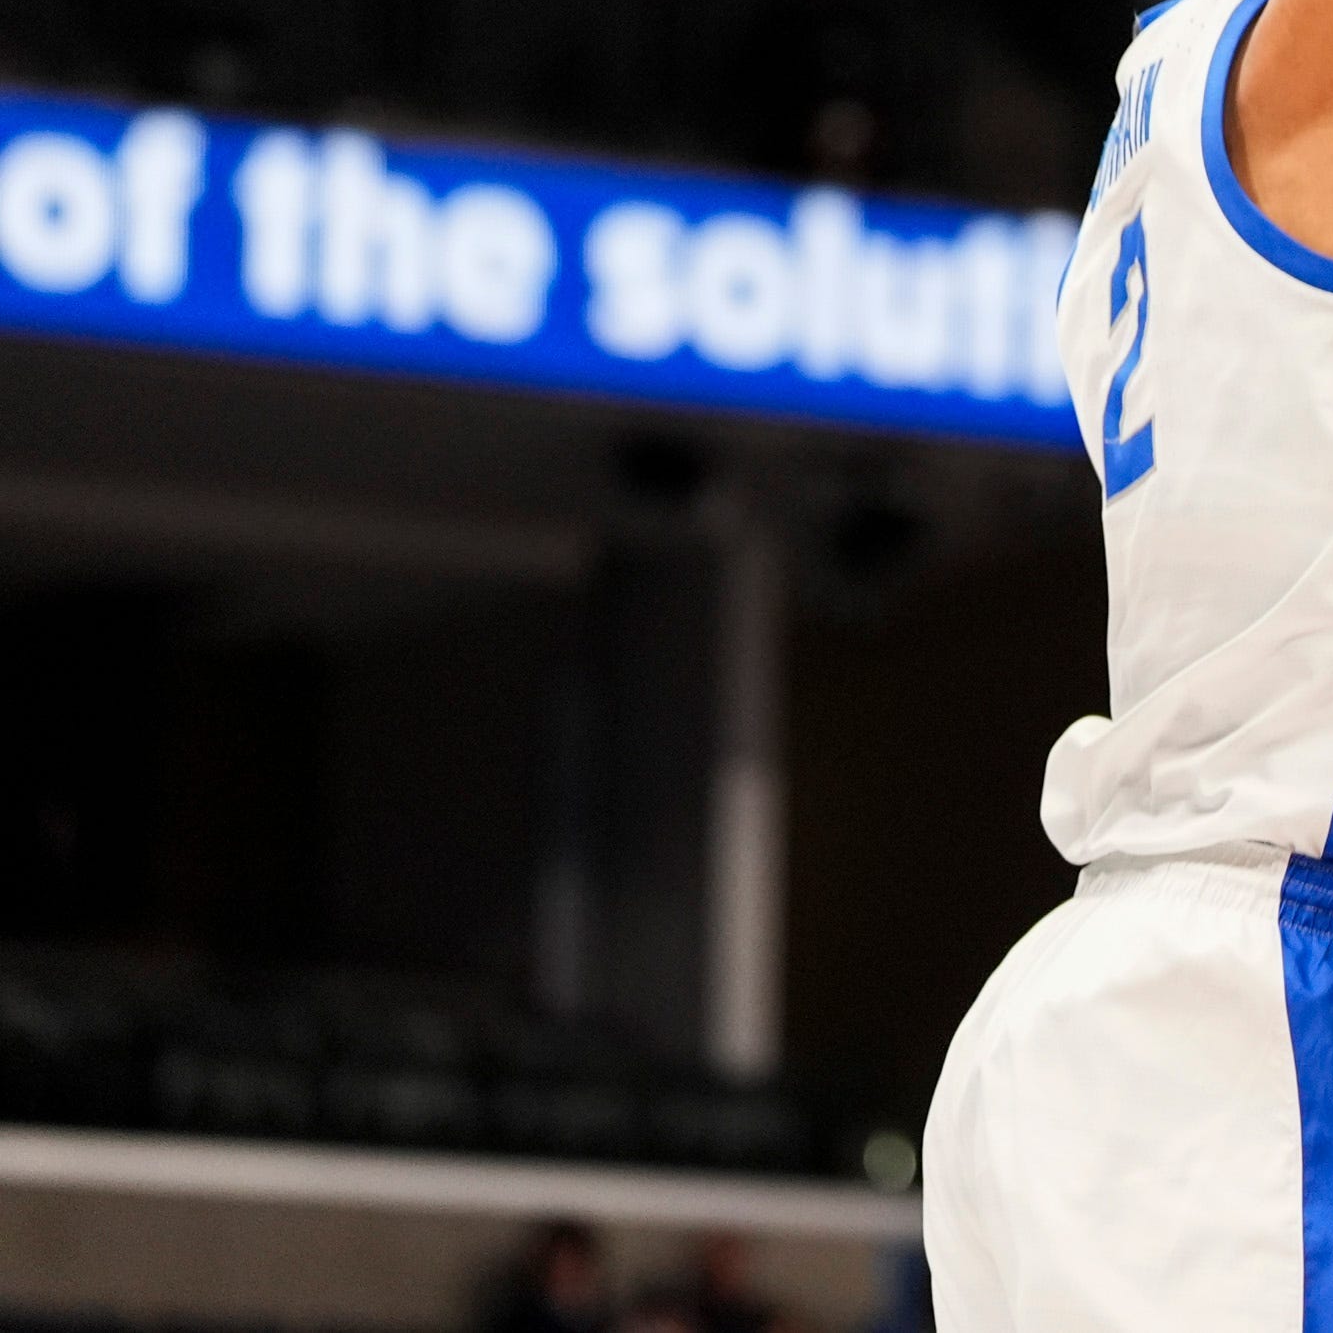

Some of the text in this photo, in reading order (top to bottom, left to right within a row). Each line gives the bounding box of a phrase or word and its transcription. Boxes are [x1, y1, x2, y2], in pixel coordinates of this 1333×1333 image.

[0, 116, 200, 302] of
[237, 131, 555, 342] the
[1102, 208, 1157, 506] 2
